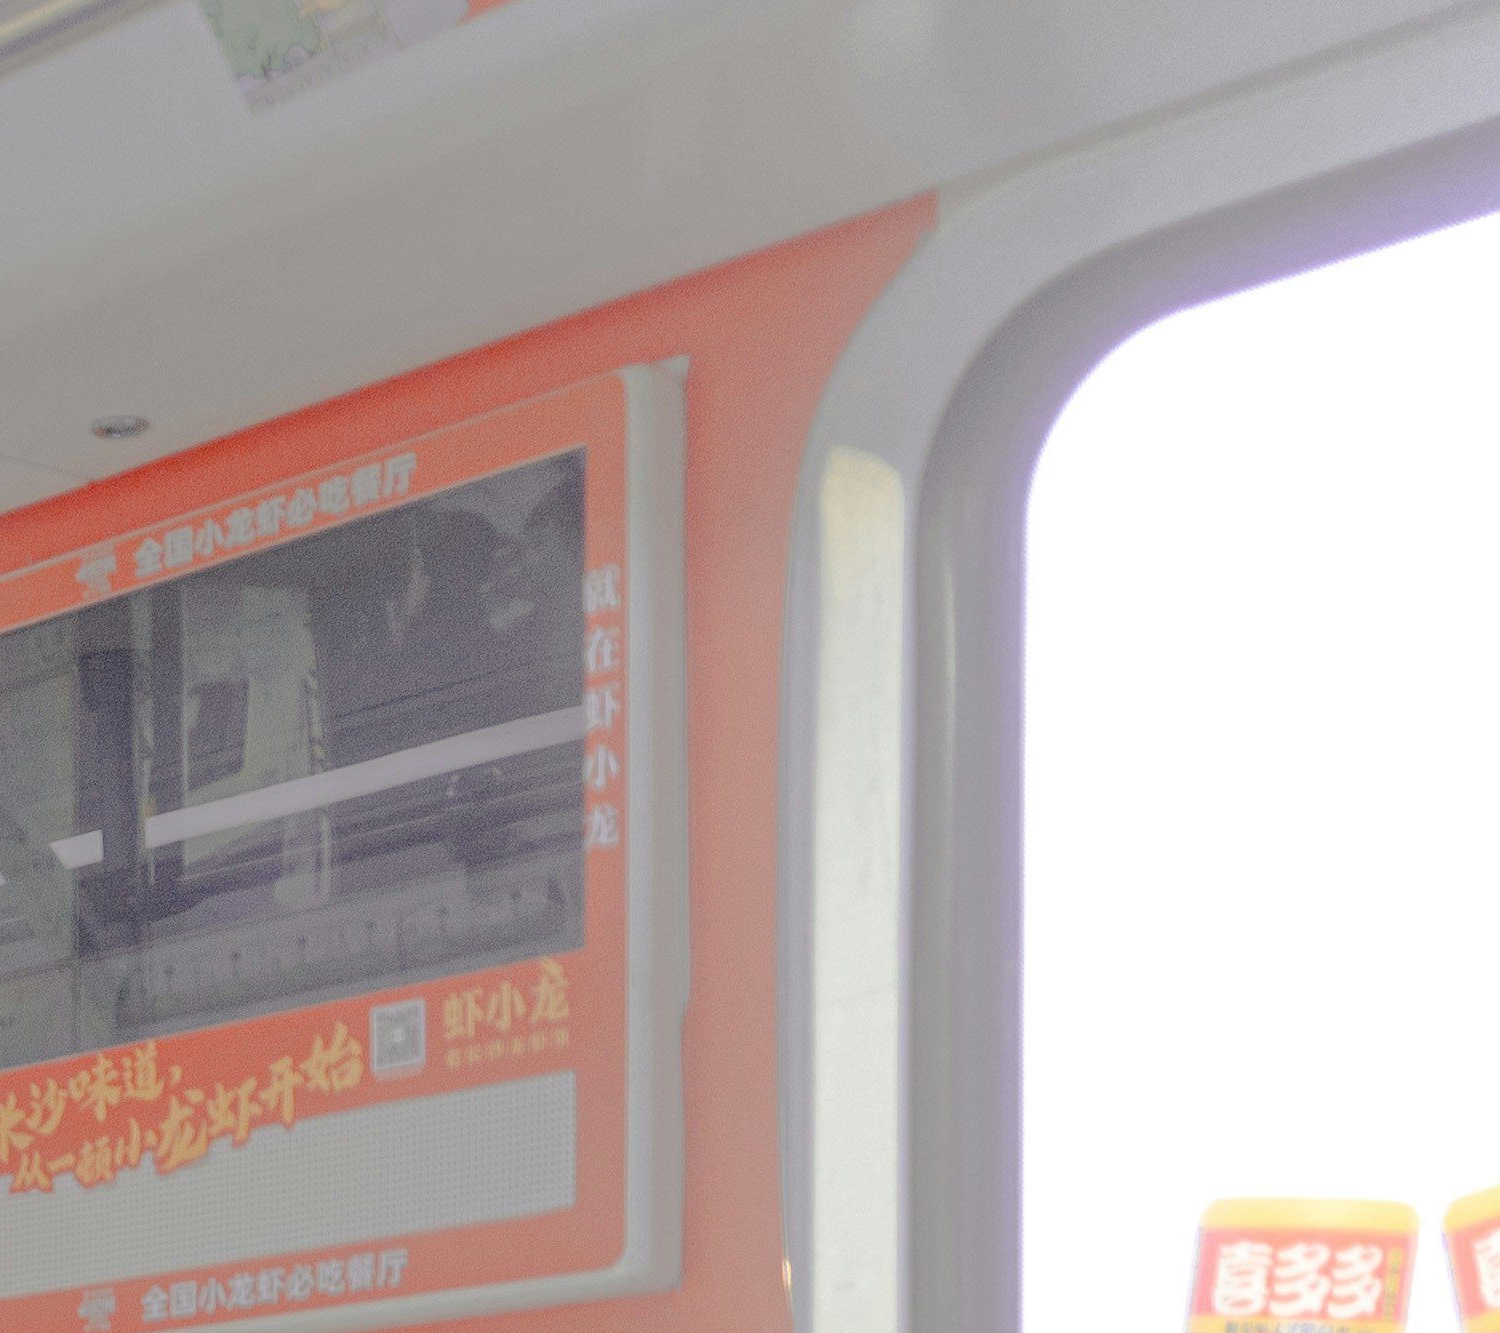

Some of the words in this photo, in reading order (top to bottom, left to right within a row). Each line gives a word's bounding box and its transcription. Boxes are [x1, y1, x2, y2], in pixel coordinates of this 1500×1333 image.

[132, 452, 418, 580] 全国小龙虾必吃餐厅
[443, 955, 569, 1040] 虾小龙
[14, 1022, 365, 1190] 从一顿小龙虾开始
[139, 1250, 409, 1324] 全国小龙虾必吃餐厅
[1211, 1240, 1385, 1319] 喜多多
